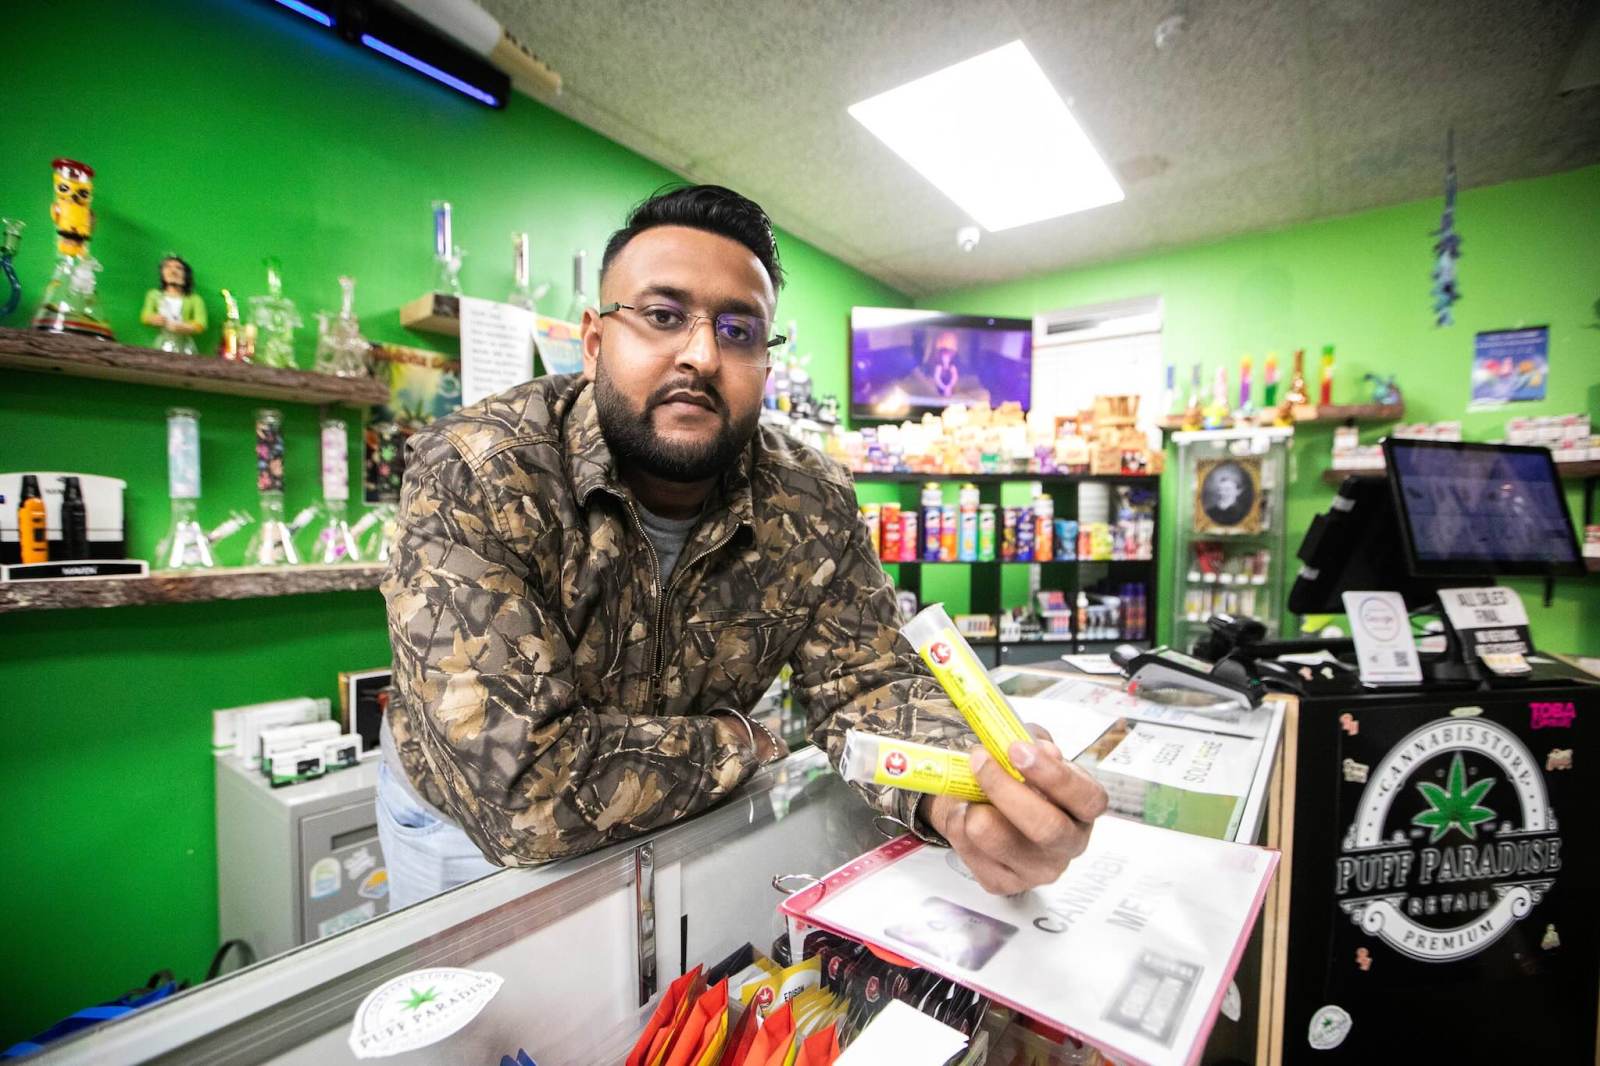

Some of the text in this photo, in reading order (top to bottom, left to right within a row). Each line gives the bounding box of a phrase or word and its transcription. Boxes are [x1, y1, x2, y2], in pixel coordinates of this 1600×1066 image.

[1381, 726, 1474, 793] CANNABIS
[1335, 837, 1562, 895] PUFF PARADISE
[1407, 891, 1490, 916] RETAIL
[1403, 919, 1494, 951] PREMIUM
[412, 976, 494, 1023] PARADISE
